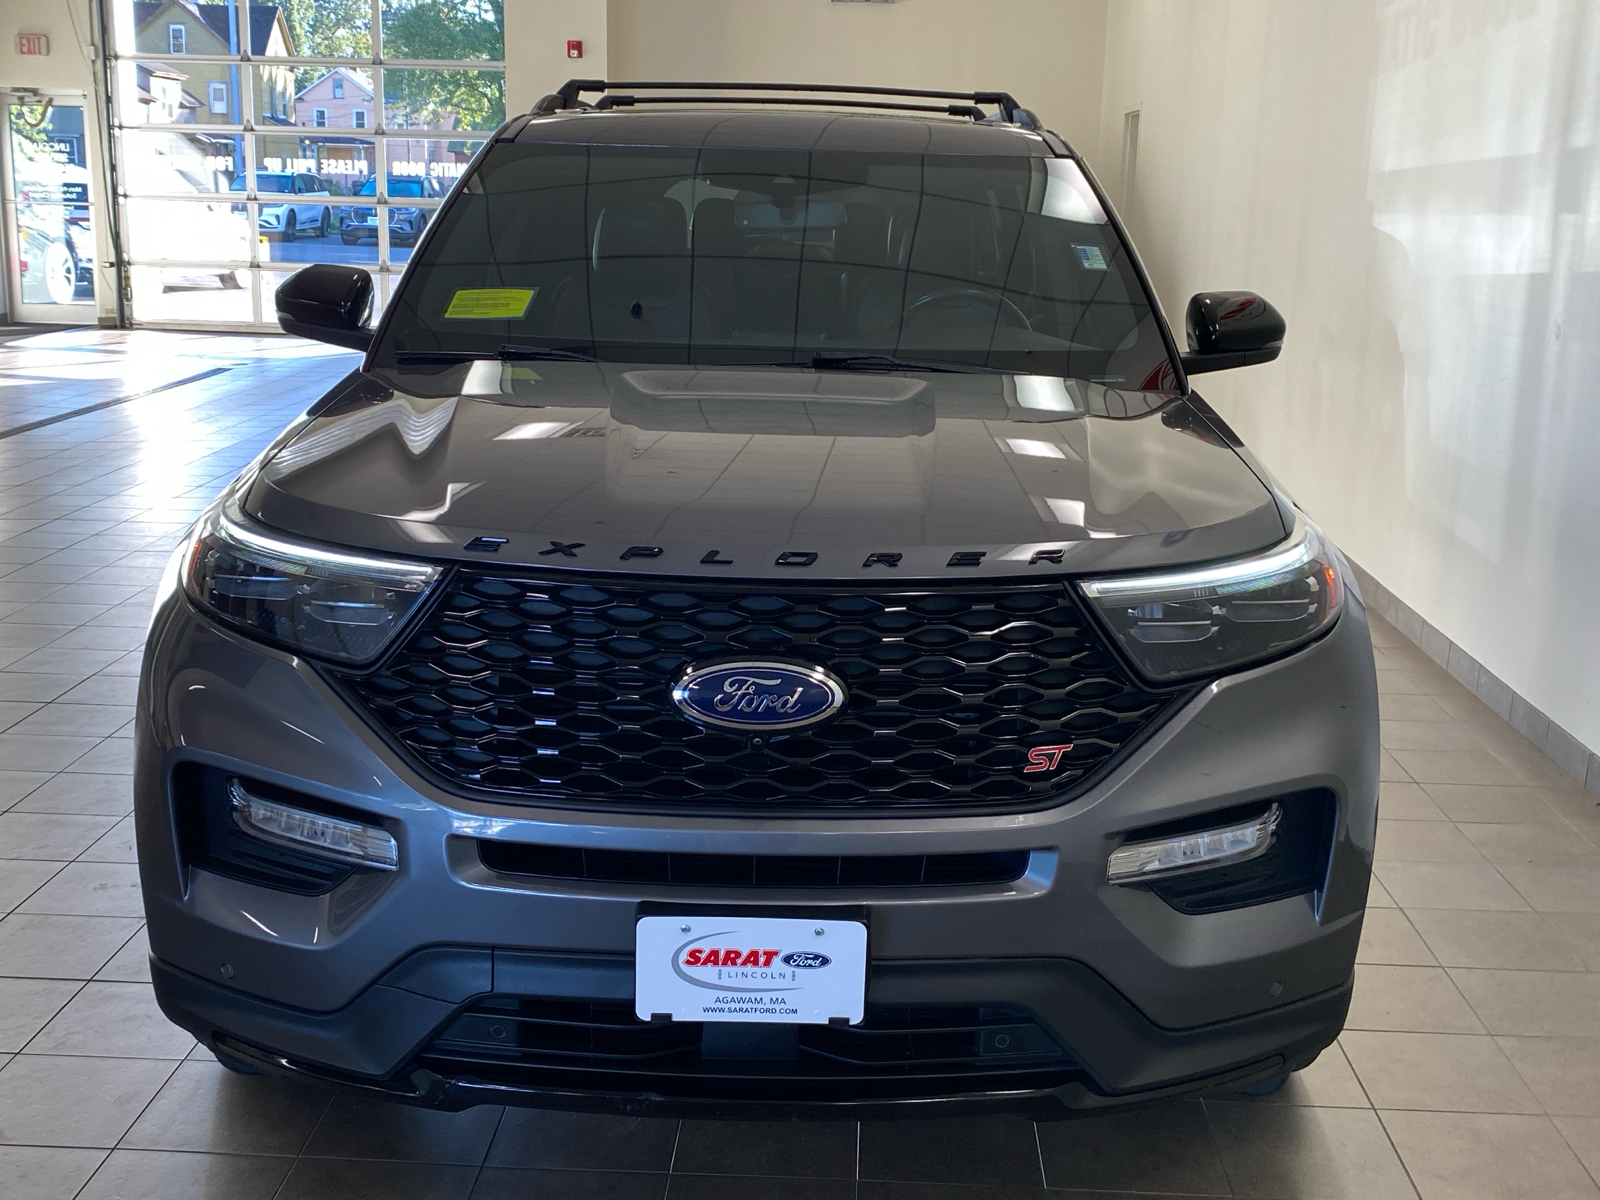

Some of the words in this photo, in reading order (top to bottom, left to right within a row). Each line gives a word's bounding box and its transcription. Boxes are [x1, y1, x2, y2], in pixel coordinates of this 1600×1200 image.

[19, 35, 42, 55] EXIT
[463, 536, 1066, 568] EXPLORER
[713, 675, 804, 714] Ford
[1023, 743, 1074, 773] ST
[682, 947, 782, 968] SARAT
[727, 971, 786, 980] LINCOLN
[702, 1006, 798, 1015] WWW.SARATFORD.COM
[714, 996, 767, 1006] AGAWAM,
[769, 997, 787, 1005] MA
